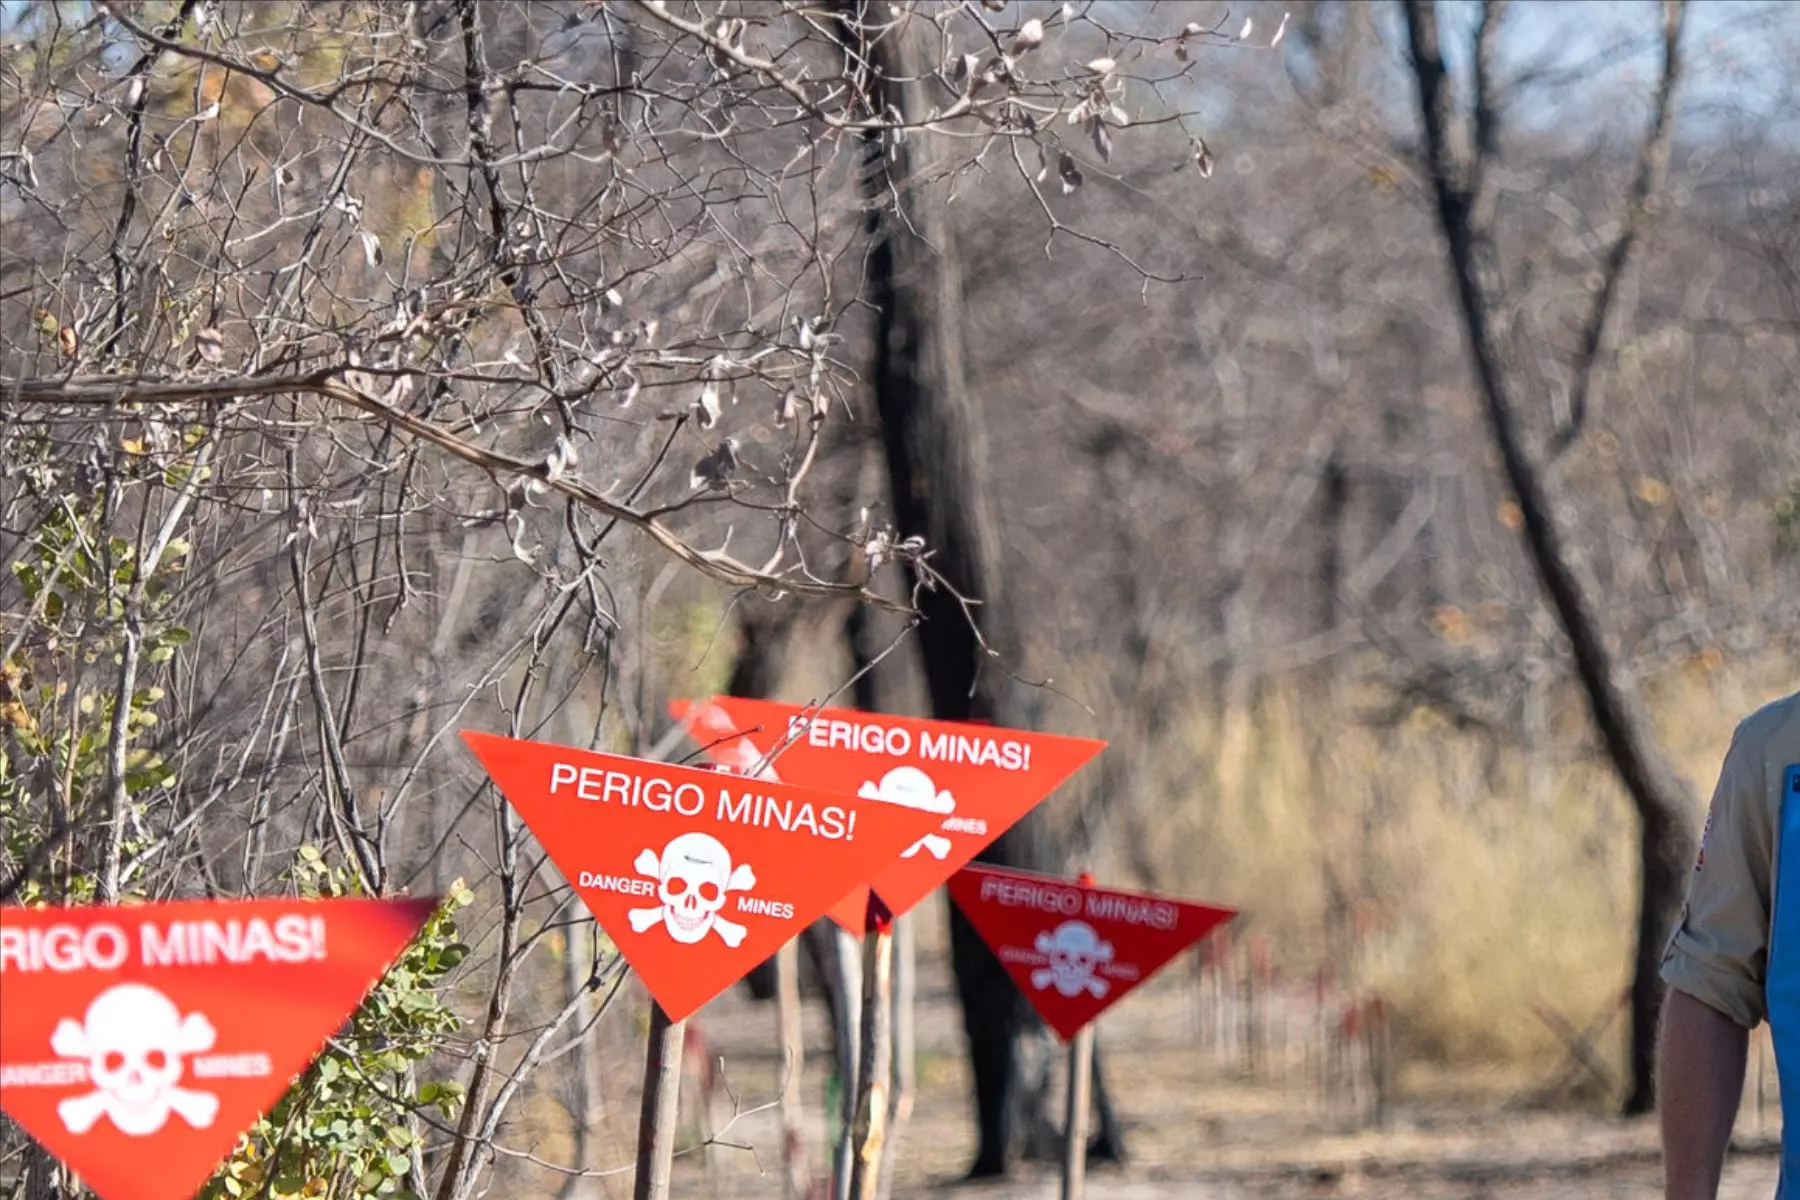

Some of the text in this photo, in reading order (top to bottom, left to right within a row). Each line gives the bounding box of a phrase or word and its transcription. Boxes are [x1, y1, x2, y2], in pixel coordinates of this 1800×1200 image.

[788, 715, 1031, 771] PERIGO MINAS!
[550, 762, 858, 842] PERIGO MINAS!
[578, 871, 794, 920] DANGER MINES
[981, 876, 1179, 930] PERIGO MINAS!
[140, 914, 328, 966] MINAS!
[193, 1052, 272, 1079] MINES
